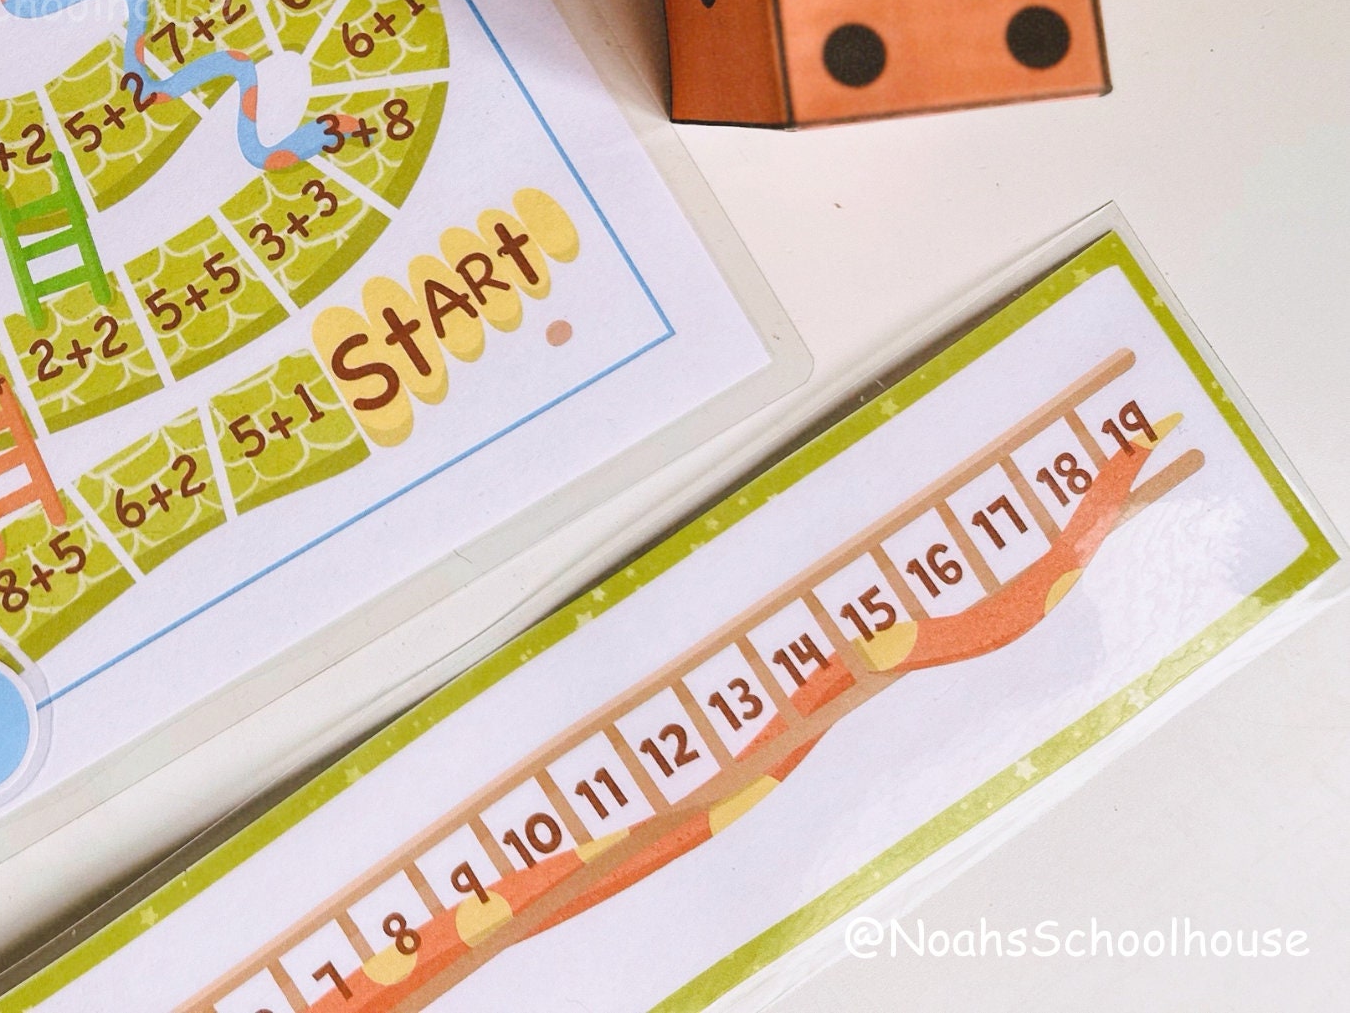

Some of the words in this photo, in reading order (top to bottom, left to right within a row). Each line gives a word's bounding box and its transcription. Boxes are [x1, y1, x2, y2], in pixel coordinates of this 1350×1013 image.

[65, 72, 157, 152] 5+2
[318, 99, 414, 153] 3+8
[250, 180, 337, 260] 3+3
[145, 253, 240, 330] 5+5
[30, 316, 127, 381] 2+2
[229, 384, 324, 457] 5+1
[116, 455, 205, 527] 6+2
[312, 961, 354, 1001] 7
[383, 914, 420, 954] 8
[451, 861, 490, 905] 9
[504, 814, 561, 868] 10
[576, 769, 628, 819] 11
[641, 725, 699, 776] 12
[710, 679, 762, 730] 13
[774, 634, 829, 686] 14
[842, 586, 896, 641] 15
[908, 545, 962, 597] 16
[972, 495, 1027, 548] 17
[1038, 453, 1092, 505] 18
[1102, 401, 1157, 453] 19
